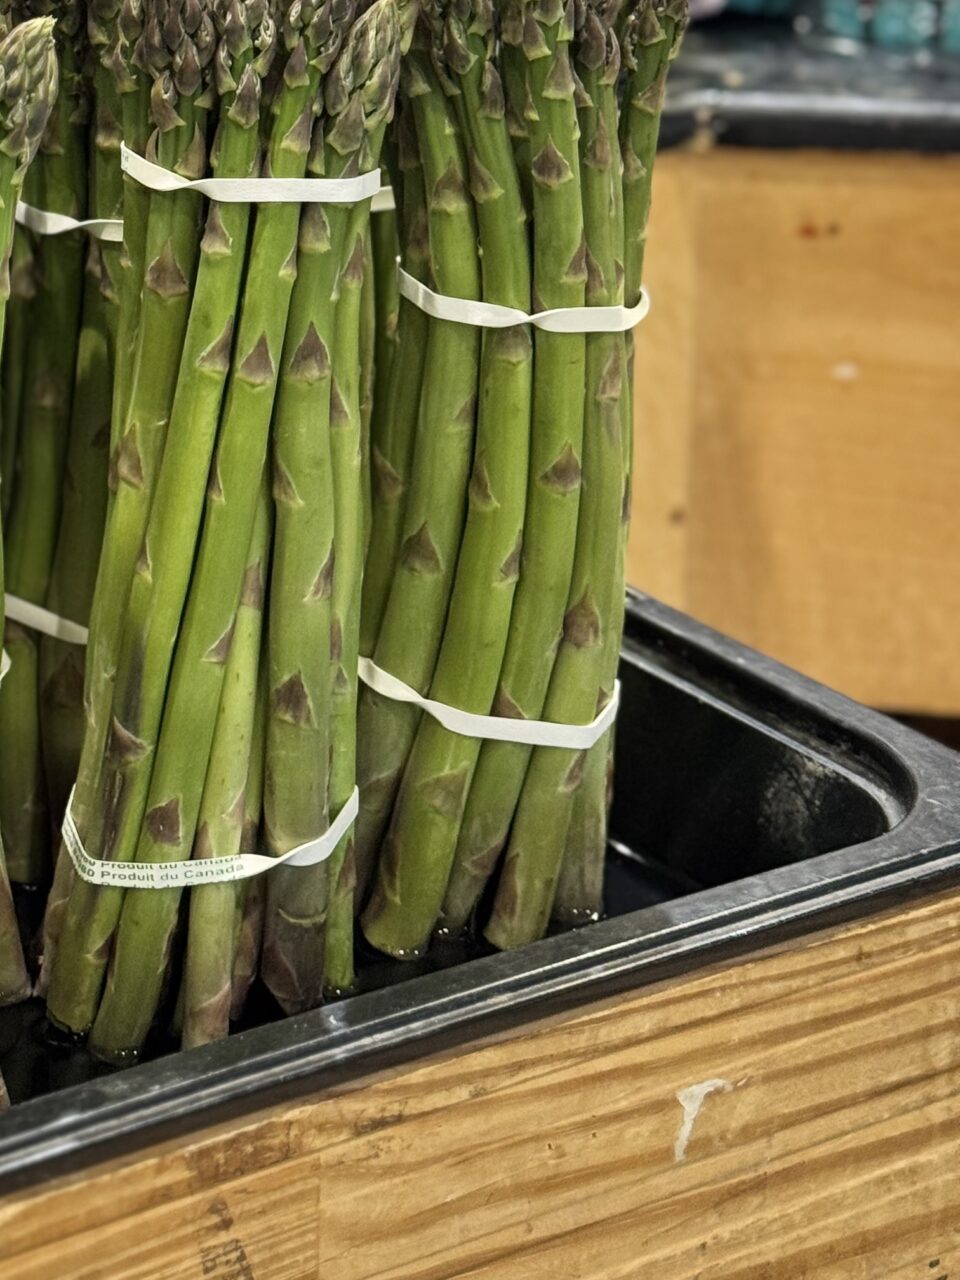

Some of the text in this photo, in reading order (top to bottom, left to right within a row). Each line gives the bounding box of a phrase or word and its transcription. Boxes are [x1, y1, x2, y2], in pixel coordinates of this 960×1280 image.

[101, 870, 155, 882] Produit
[160, 870, 179, 881] du
[184, 863, 245, 879] Canada
